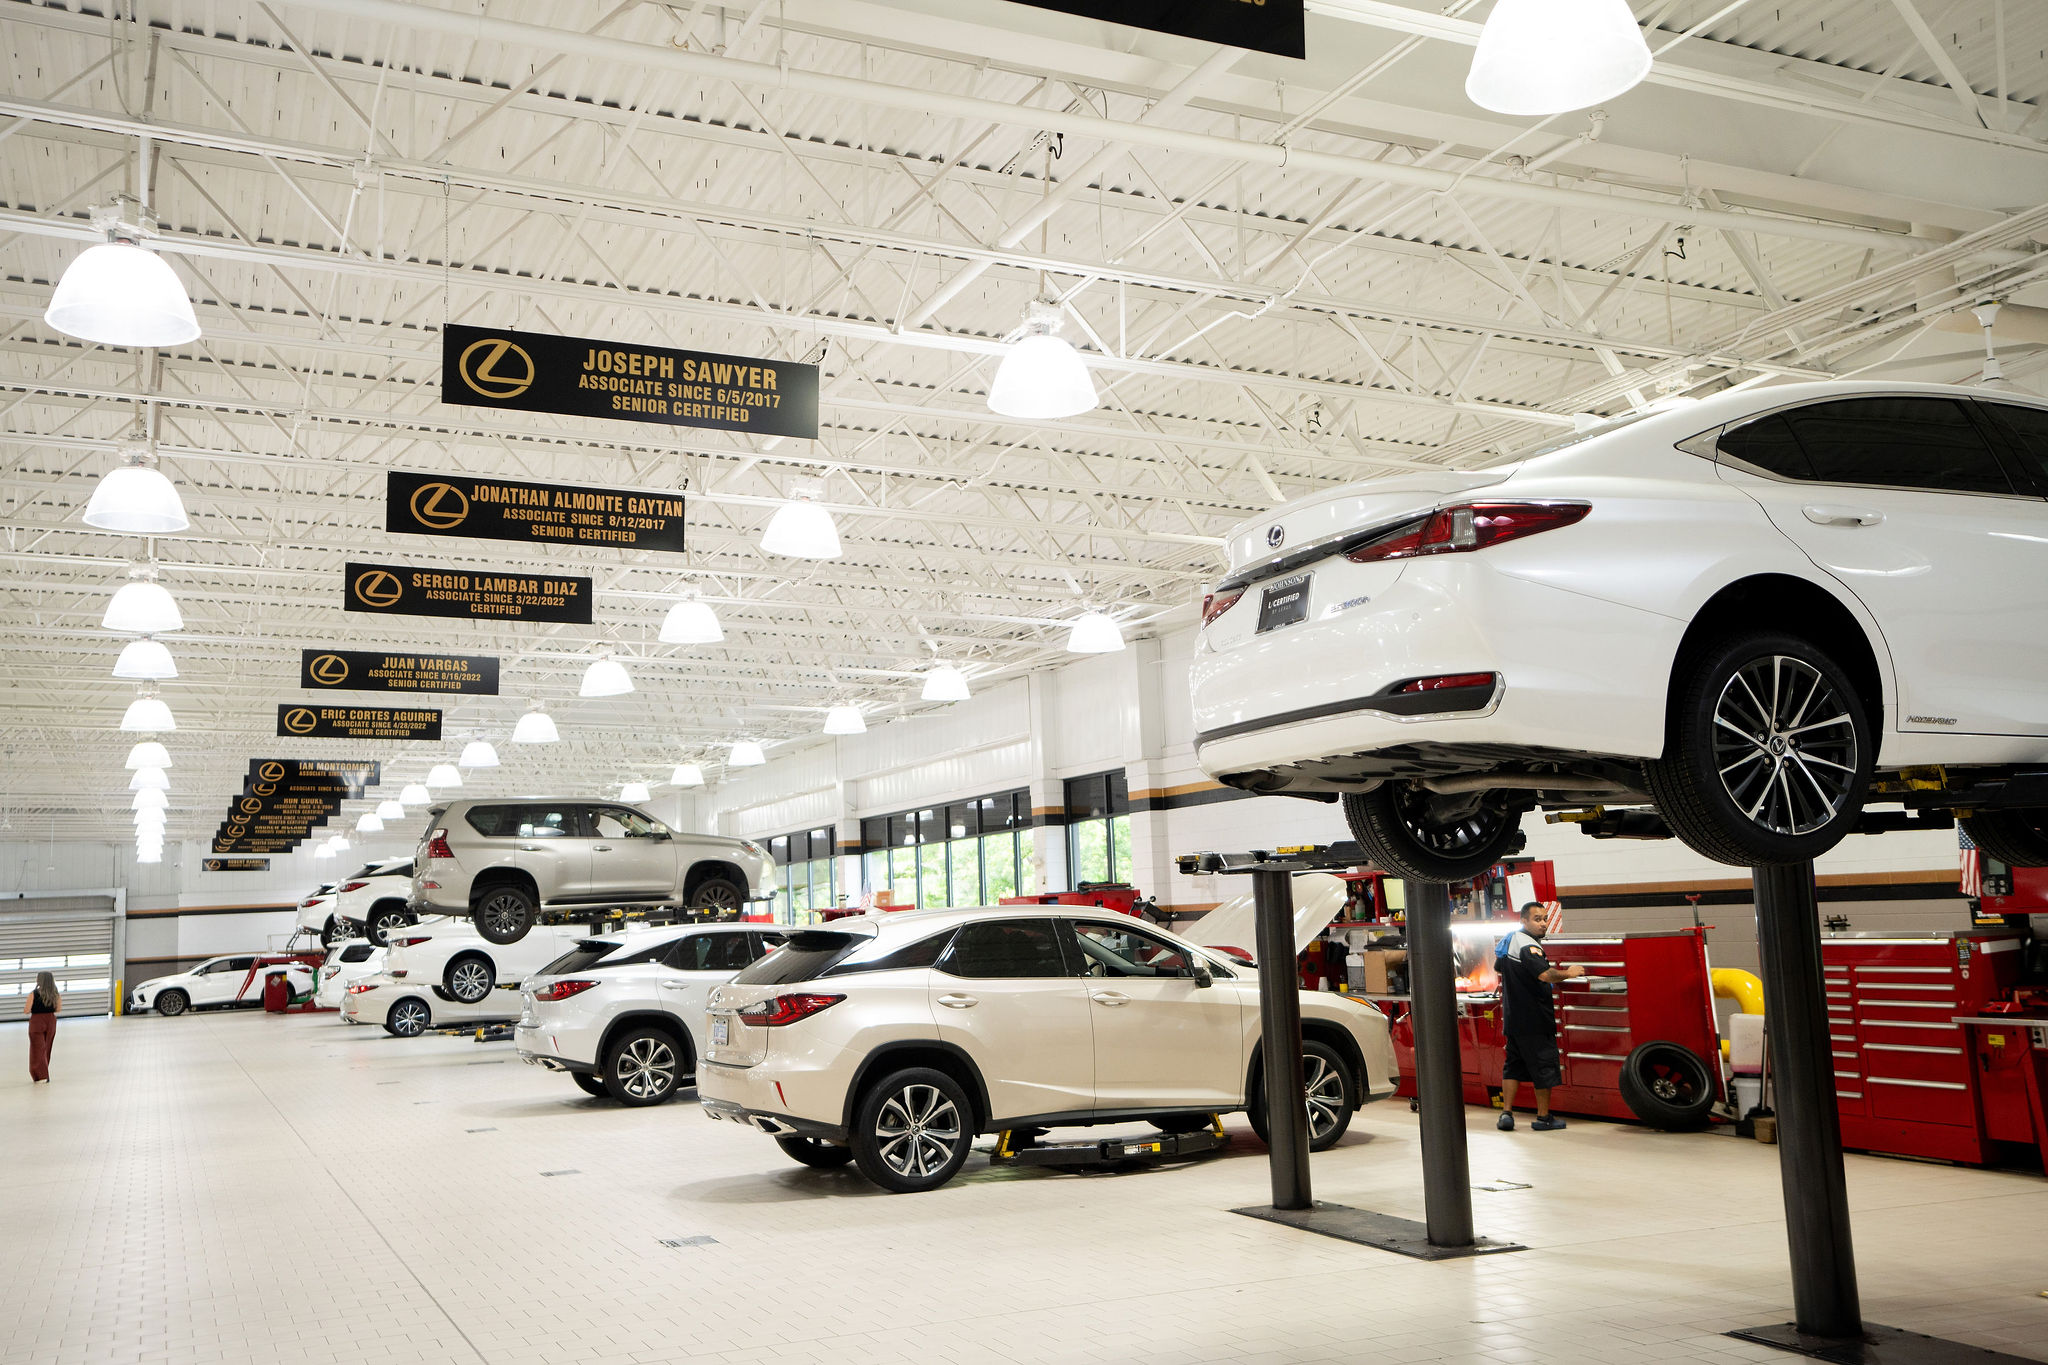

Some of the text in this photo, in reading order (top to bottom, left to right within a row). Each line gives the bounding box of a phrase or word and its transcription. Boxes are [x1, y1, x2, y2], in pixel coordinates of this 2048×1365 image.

[583, 349, 776, 390] JOSEPH SAWYER
[579, 374, 780, 408] ASSOCIATE SINCE 6/5/2017
[611, 395, 749, 422] SENIOR CERTIFIED
[471, 486, 682, 517] JONATHAN ALMONTE GAYTAN
[504, 508, 665, 531] ASSOCIATE SINCE 8/12/2017
[531, 525, 637, 543] SENIOR CERTIFIED
[412, 573, 577, 595] SERGIO LAMBAR DIAZ
[426, 590, 564, 606] ASSOCIATE SINCE 3/22/2022
[471, 604, 521, 615] CERTIFIED
[382, 657, 467, 672] JUAN VARGAS
[368, 669, 413, 678] ASSOCIATE
[441, 672, 481, 681] 8/16/2022
[388, 680, 462, 689] SENIOR CERTIFIED
[320, 709, 438, 722] ERIC CORTES AGUIRRE
[348, 728, 374, 736] SENIOR
[299, 762, 376, 772] IAN MONTGOMERY
